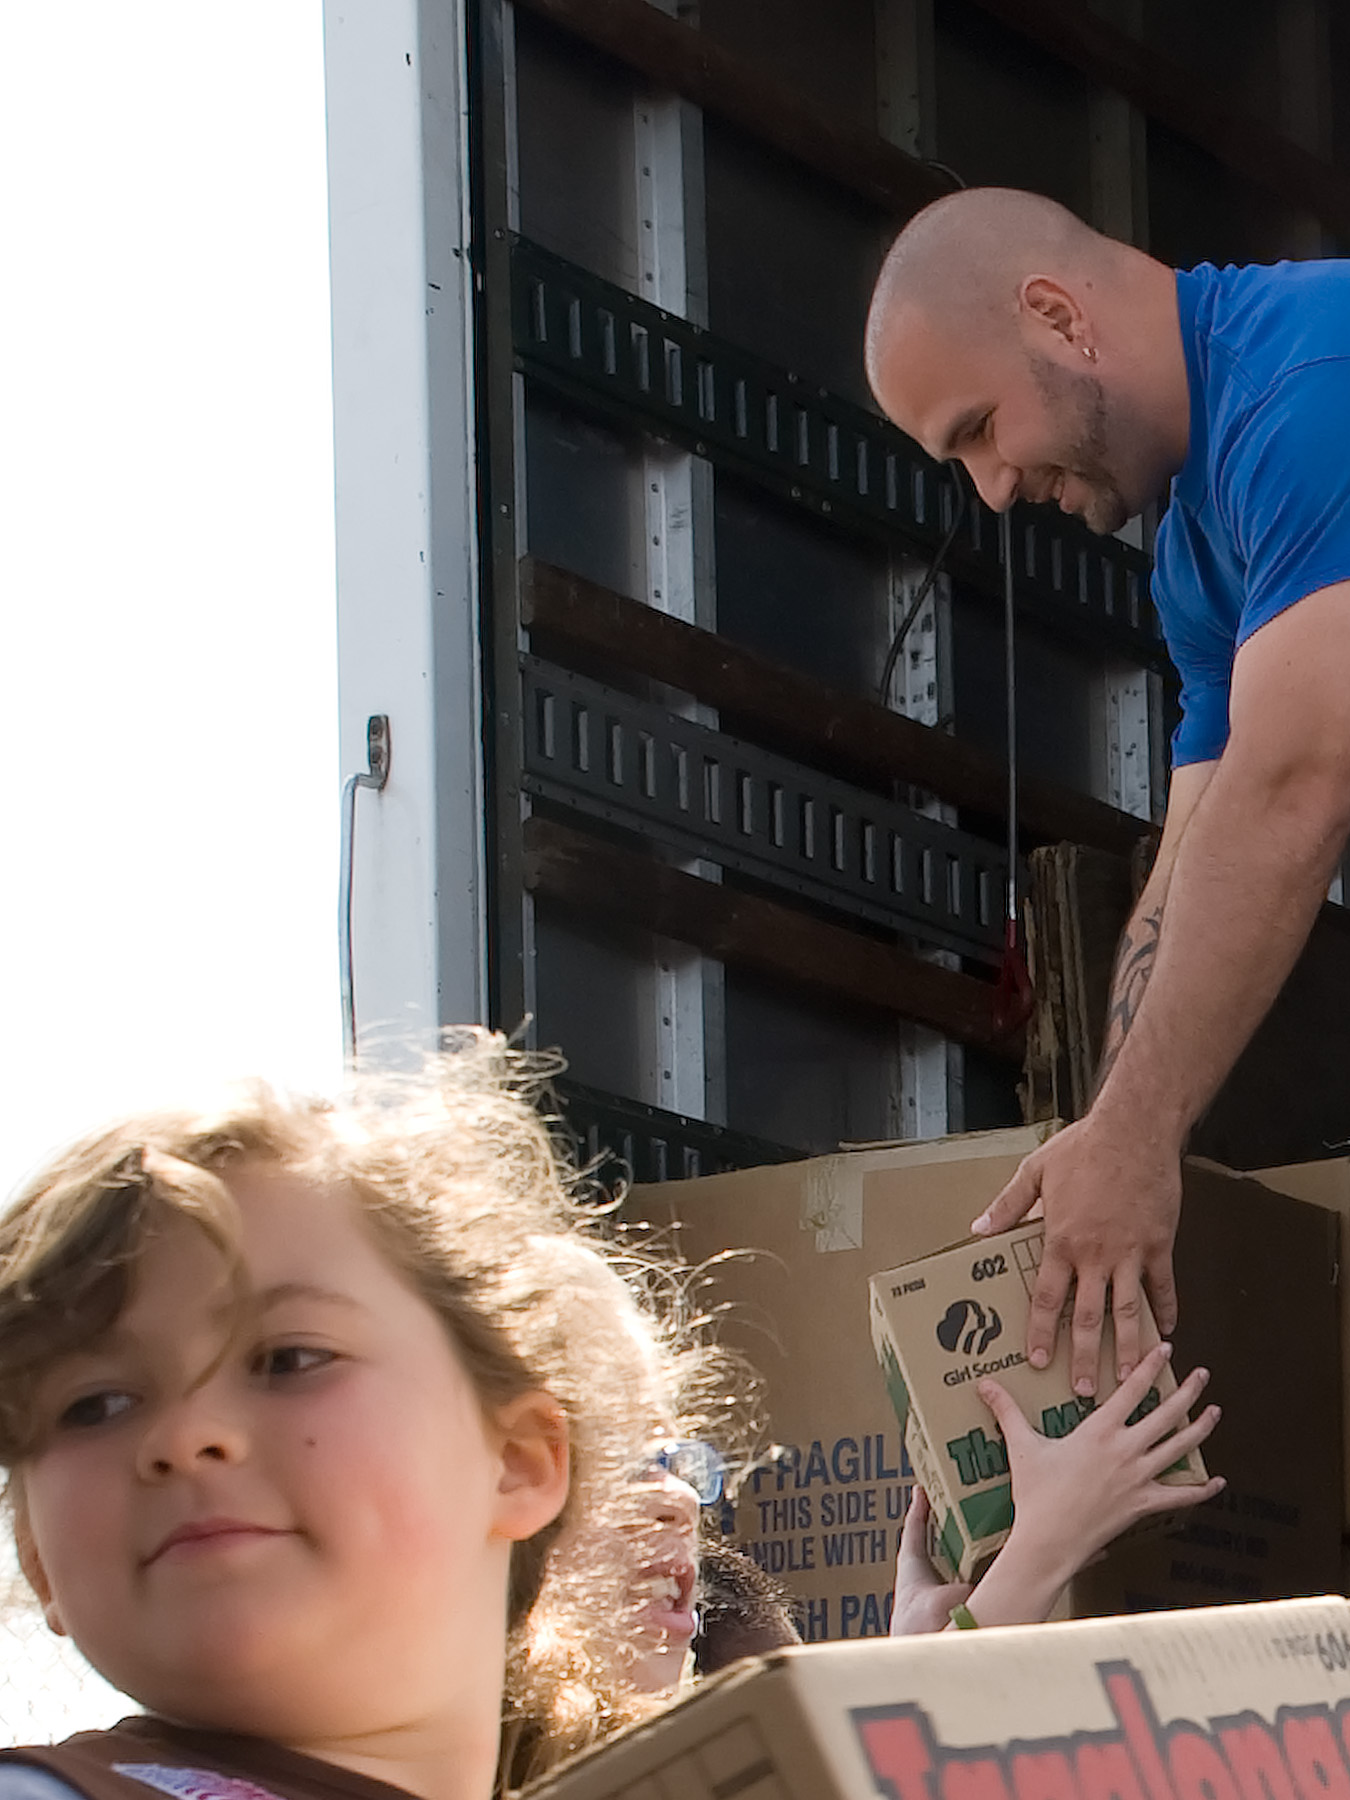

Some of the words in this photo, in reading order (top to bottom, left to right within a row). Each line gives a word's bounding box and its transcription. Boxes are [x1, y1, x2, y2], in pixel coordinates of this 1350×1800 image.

[972, 1255, 1008, 1282] 602
[943, 1366, 972, 1387] Girl
[947, 1427, 1010, 1486] Th
[757, 1496, 812, 1534] THIS
[821, 1489, 877, 1527] SIDE
[741, 1536, 816, 1575] NDLE
[822, 1529, 887, 1568] WITH
